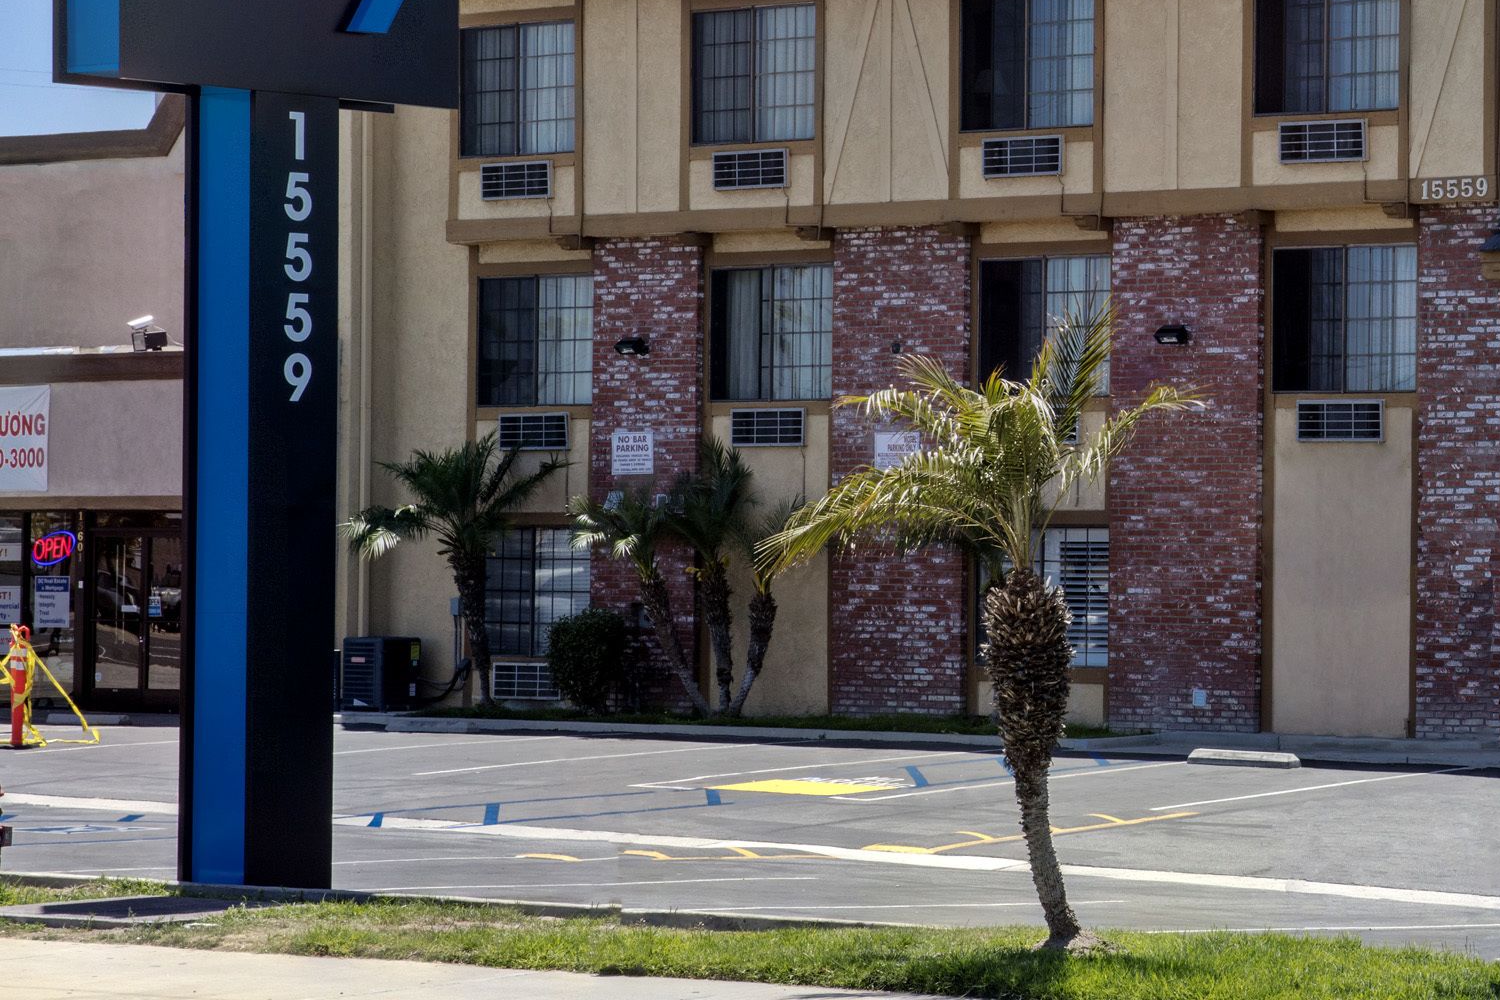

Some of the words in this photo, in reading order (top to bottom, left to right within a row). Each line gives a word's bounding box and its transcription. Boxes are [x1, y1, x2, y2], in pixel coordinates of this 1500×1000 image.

[1421, 177, 1488, 200] 15559
[283, 111, 313, 403] 15559
[616, 444, 649, 452] PARKING
[618, 435, 629, 443] NO
[633, 435, 647, 443] BAR
[33, 536, 72, 560] OPEN
